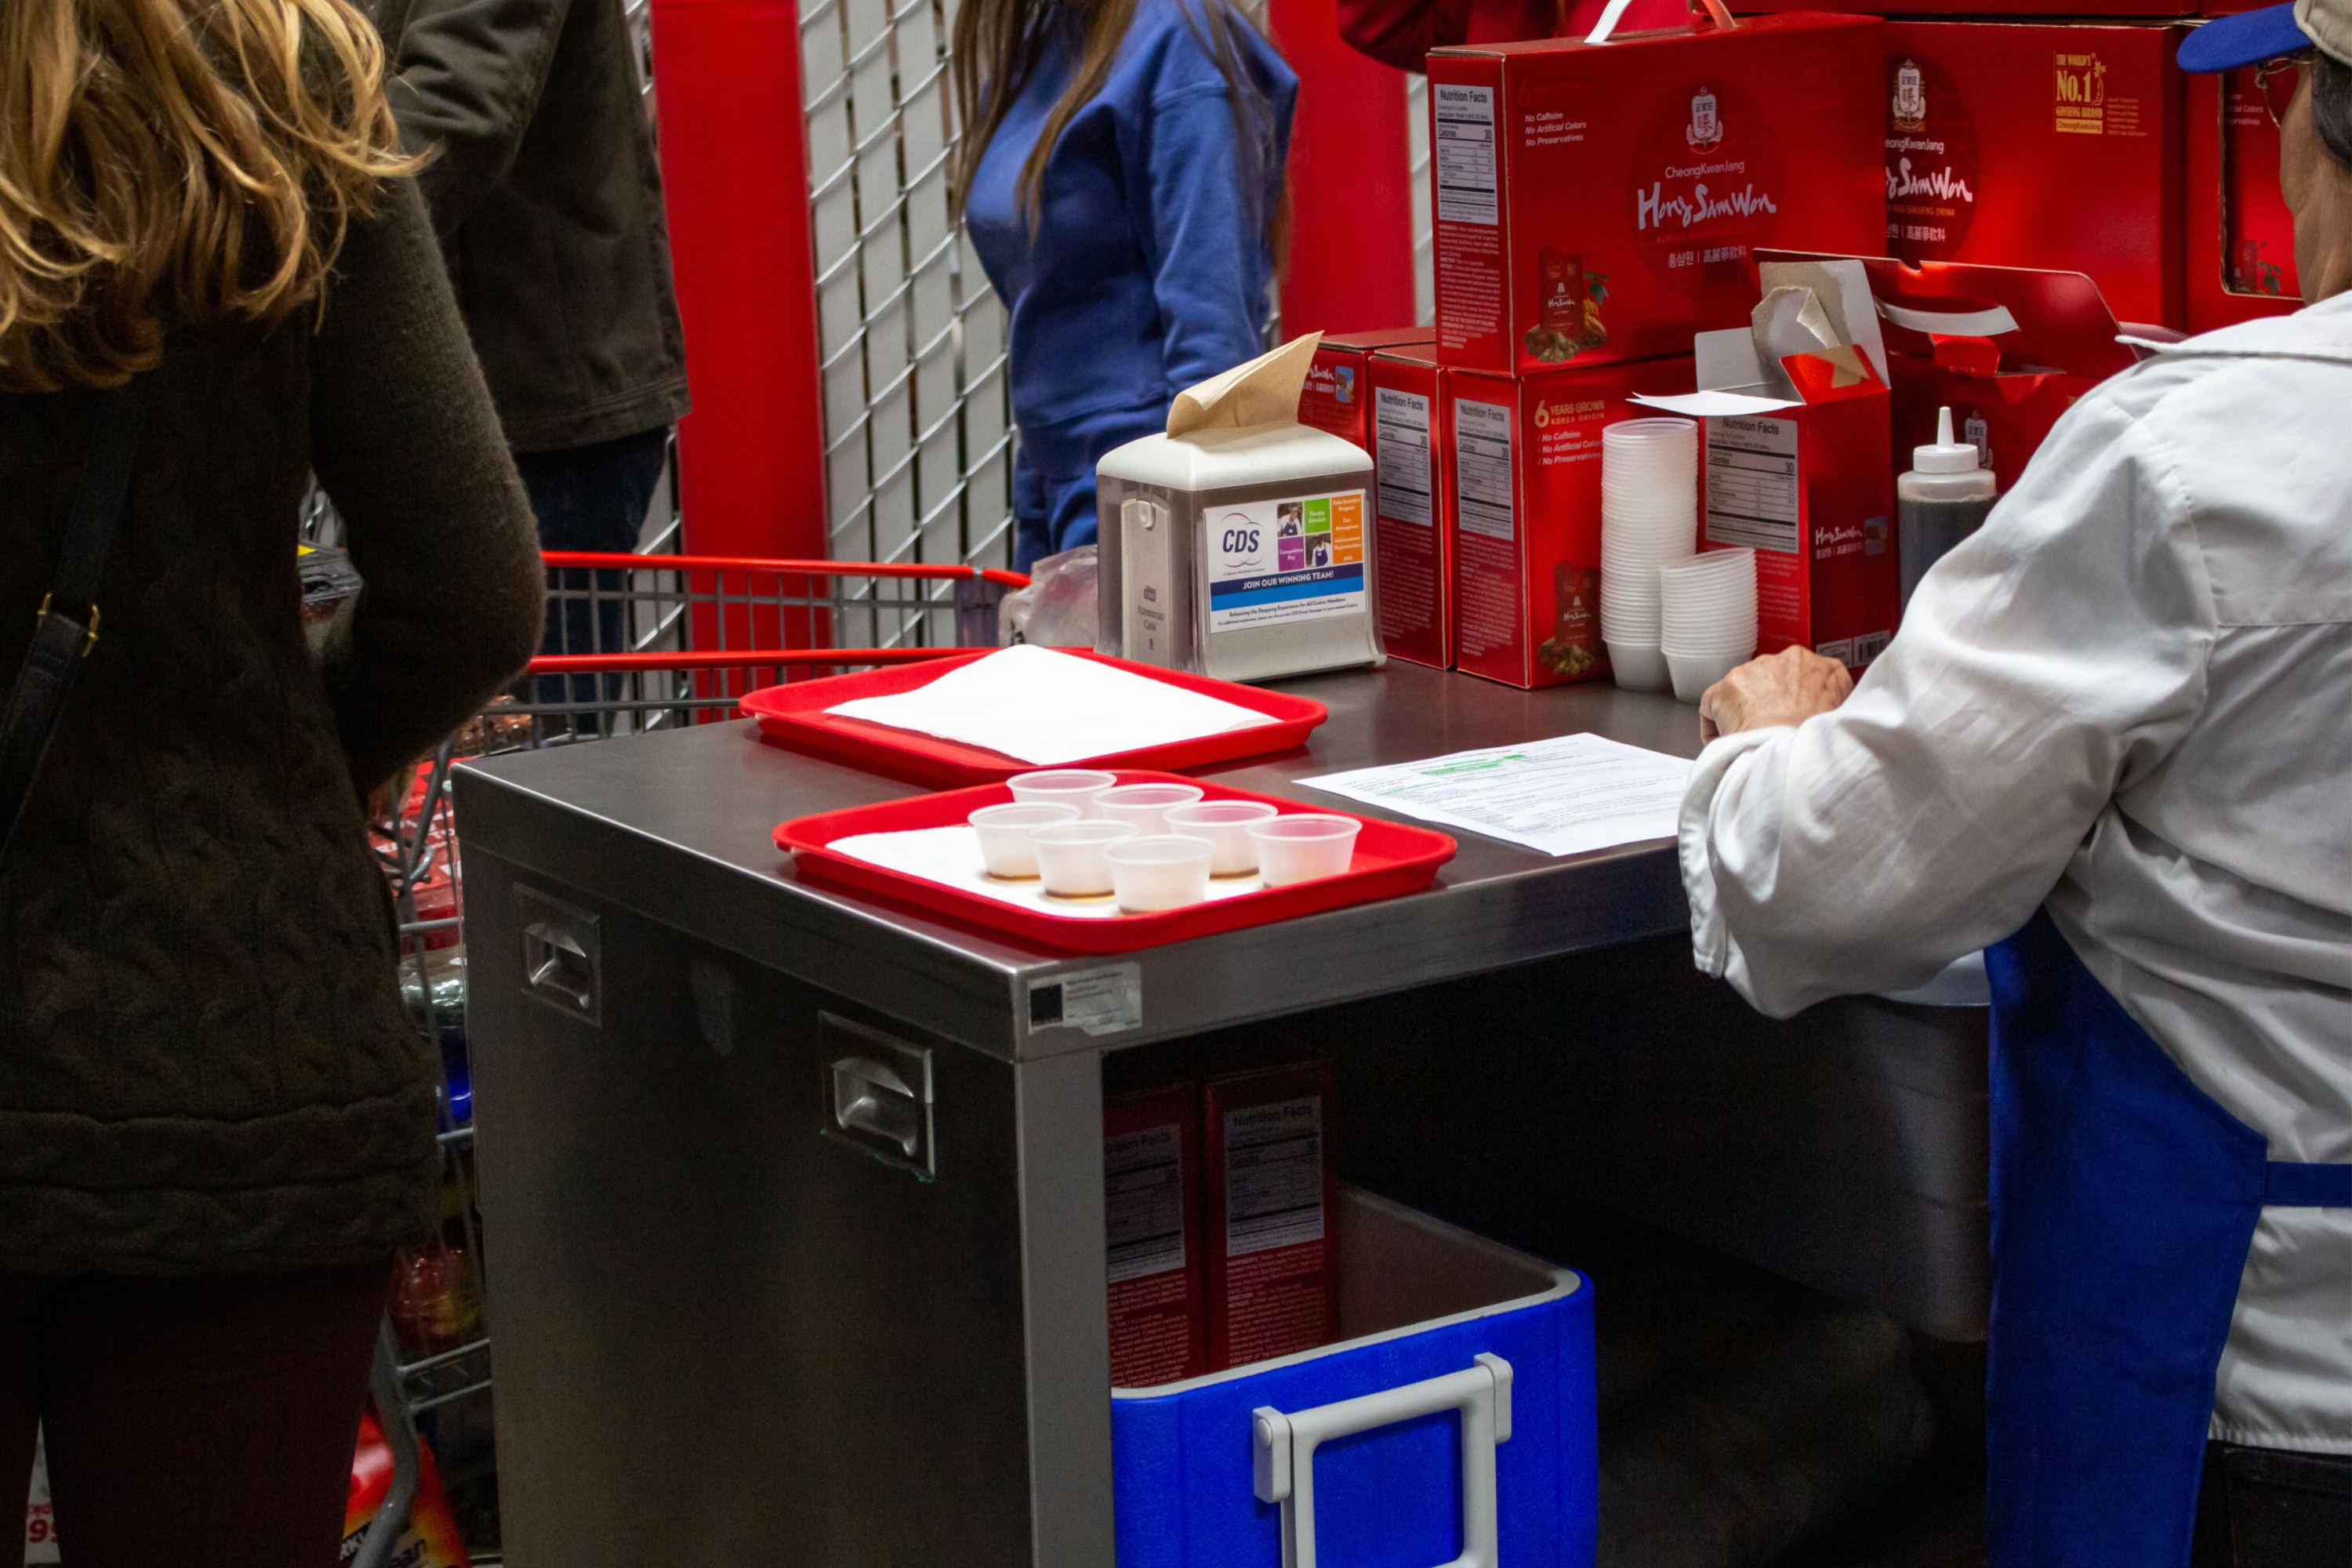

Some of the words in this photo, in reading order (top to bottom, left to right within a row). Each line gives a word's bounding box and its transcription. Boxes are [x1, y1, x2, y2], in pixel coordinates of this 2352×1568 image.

[1440, 89, 1468, 102] Nutrition
[1469, 92, 1487, 103] Facts
[1537, 112, 1563, 121] Caffeine
[1537, 123, 1564, 132] Artificial
[1565, 122, 1587, 130] Colors
[1537, 134, 1584, 145] Preservatives
[1664, 160, 1745, 179] CheongKwanJang
[1668, 250, 1694, 268] 홍삼원
[1381, 393, 1406, 407] Nutrition
[1408, 397, 1424, 411] Facts
[1461, 404, 1486, 419] Nutrition
[1488, 409, 1504, 422] Facts
[1534, 400, 1549, 427] 6
[1550, 404, 1574, 416] YEARS
[1575, 400, 1604, 413] GROWN
[1551, 416, 1575, 425] KOREA
[1578, 413, 1605, 422] ORIGIN
[1722, 417, 1755, 432] Nutrition
[1758, 421, 1780, 435] Facts
[1554, 430, 1581, 441] Caffeine
[1542, 445, 1552, 454] No
[1554, 441, 1581, 452] Artificial
[1543, 457, 1553, 466] No
[1785, 462, 1795, 474] 30
[1223, 529, 1260, 554] CDS
[1243, 579, 1260, 590] JOIN
[1261, 578, 1276, 586] OUR
[1277, 573, 1311, 584] WINNING
[1312, 570, 1334, 579] TEAM!
[1283, 1104, 1312, 1116] Facts
